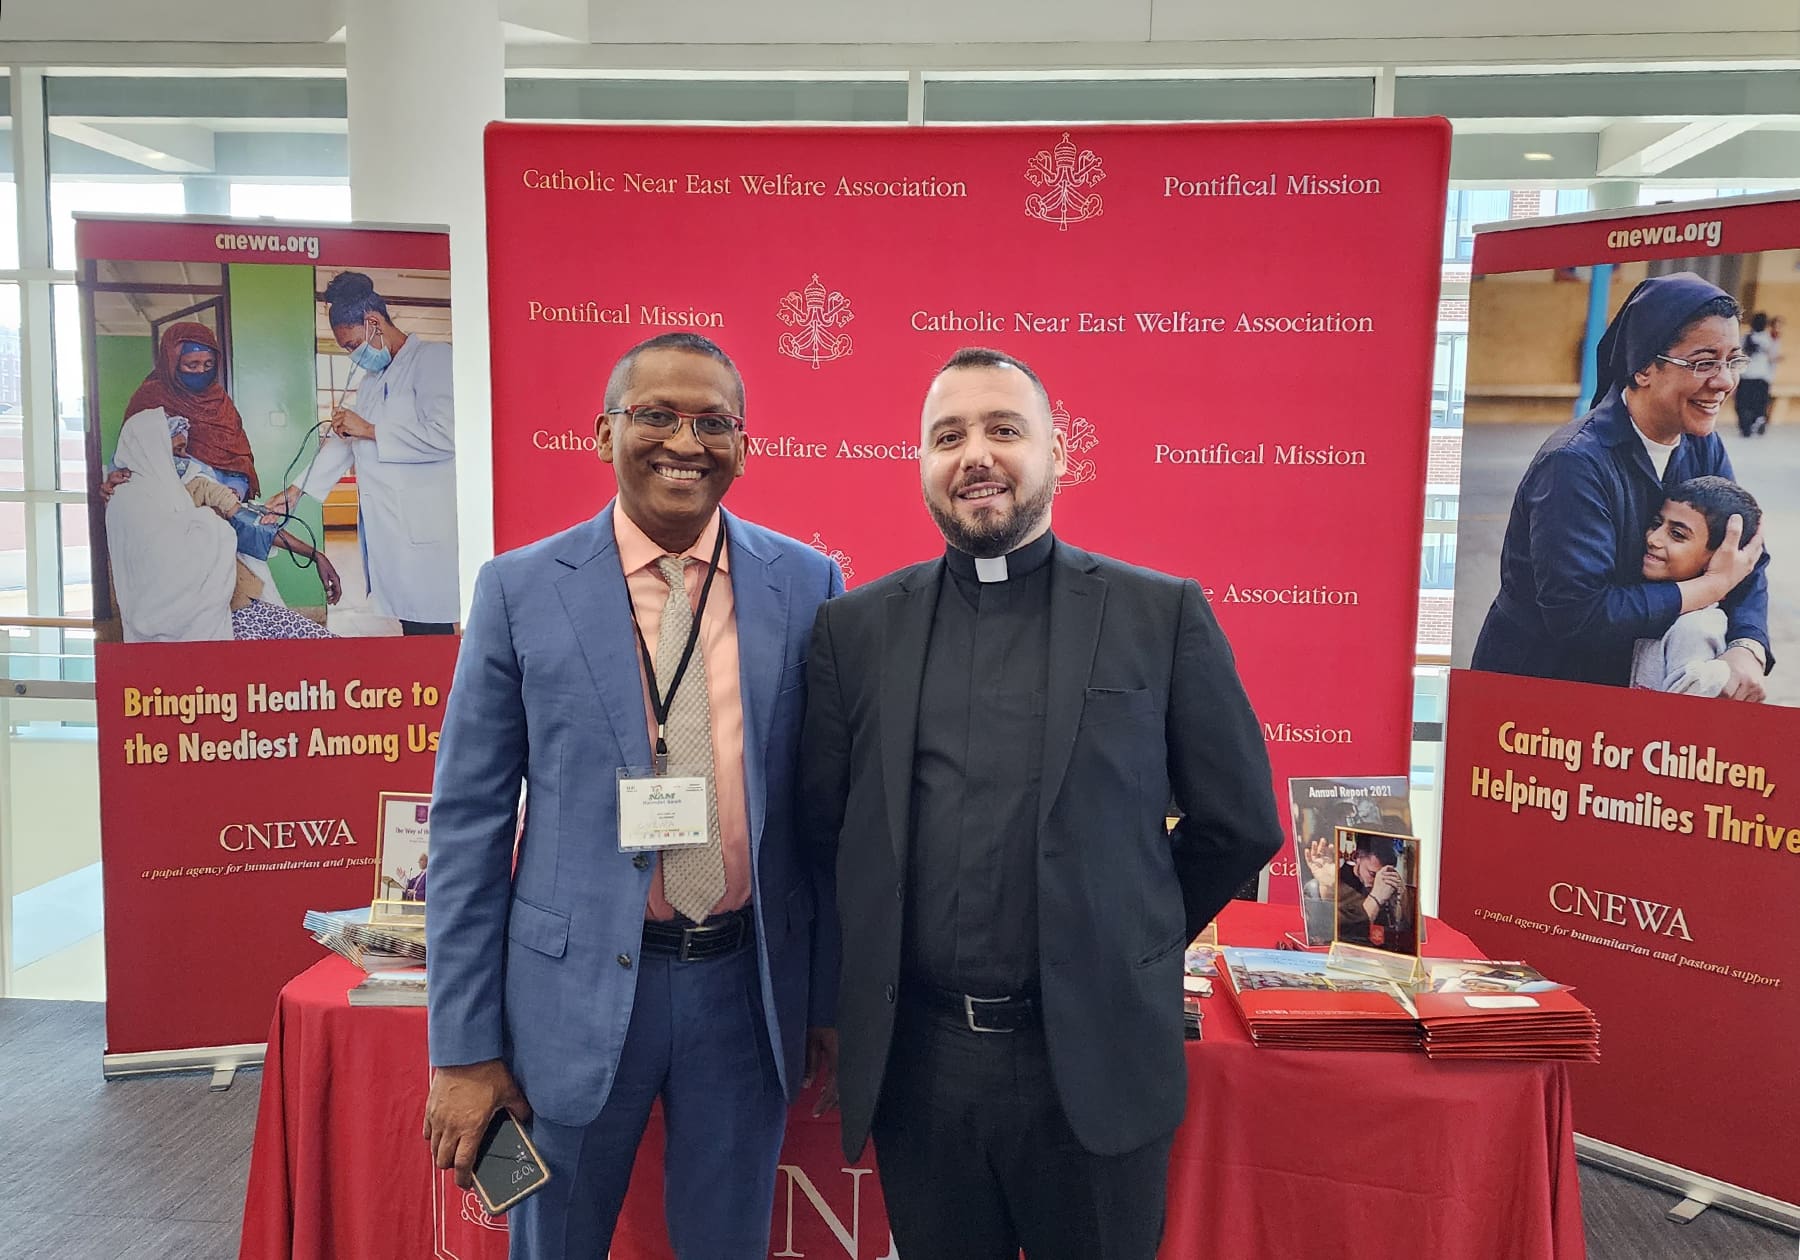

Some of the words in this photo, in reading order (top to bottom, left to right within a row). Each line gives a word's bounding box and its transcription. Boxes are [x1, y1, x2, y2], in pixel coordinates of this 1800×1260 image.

[523, 169, 615, 192] Catholic
[623, 172, 678, 194] Near
[685, 174, 732, 195] East
[740, 173, 826, 196] Welfare
[834, 175, 968, 197] Association
[1163, 173, 1277, 197] Pontifical
[1285, 174, 1381, 195] Mission
[215, 233, 320, 259] cnewa.org
[1607, 220, 1722, 249] cnewa.org
[528, 301, 630, 324] Pontifical
[639, 305, 725, 328] Mission
[911, 310, 1005, 332] Catholic
[1013, 312, 1070, 333] Near
[1077, 312, 1127, 333] East
[1134, 311, 1226, 333] Welfare
[1233, 312, 1375, 333] Association
[532, 430, 597, 452] Catho
[748, 436, 827, 459] Welfare
[836, 438, 920, 460] Associa
[1154, 443, 1264, 465] Pontifical
[1273, 444, 1367, 465] Mission
[1221, 583, 1359, 605] Association
[123, 687, 238, 724] Bringing
[247, 680, 336, 712] Health
[345, 679, 403, 709] Care
[412, 682, 439, 707] to
[124, 733, 168, 764] the
[178, 729, 299, 763] Neediest
[307, 727, 399, 763] Among
[407, 724, 440, 753] Us
[1263, 722, 1353, 743] Mission
[1498, 721, 1582, 772] Caring
[1591, 731, 1635, 771] for
[1642, 740, 1776, 798] Children,
[1309, 786, 1338, 798] Annual
[1340, 786, 1368, 799] Report
[1370, 785, 1392, 797] 2021
[1471, 766, 1570, 821] Helping
[1577, 783, 1694, 835] Families
[1703, 803, 1800, 855] Thrive
[219, 818, 358, 852] CNEWA
[141, 870, 150, 879] a
[151, 866, 184, 880] papal
[185, 864, 224, 879] agency
[224, 861, 242, 877] for
[244, 858, 320, 874] humanitarian
[322, 857, 345, 869] and
[1548, 881, 1695, 942] CNEWA
[1474, 907, 1482, 917] a
[1483, 908, 1513, 925] papal
[1514, 916, 1552, 935] agency
[1550, 923, 1570, 937] for
[1570, 928, 1651, 957] humanitarian
[1652, 950, 1678, 964] and
[1678, 955, 1730, 977] pastoral
[1730, 969, 1782, 989] support
